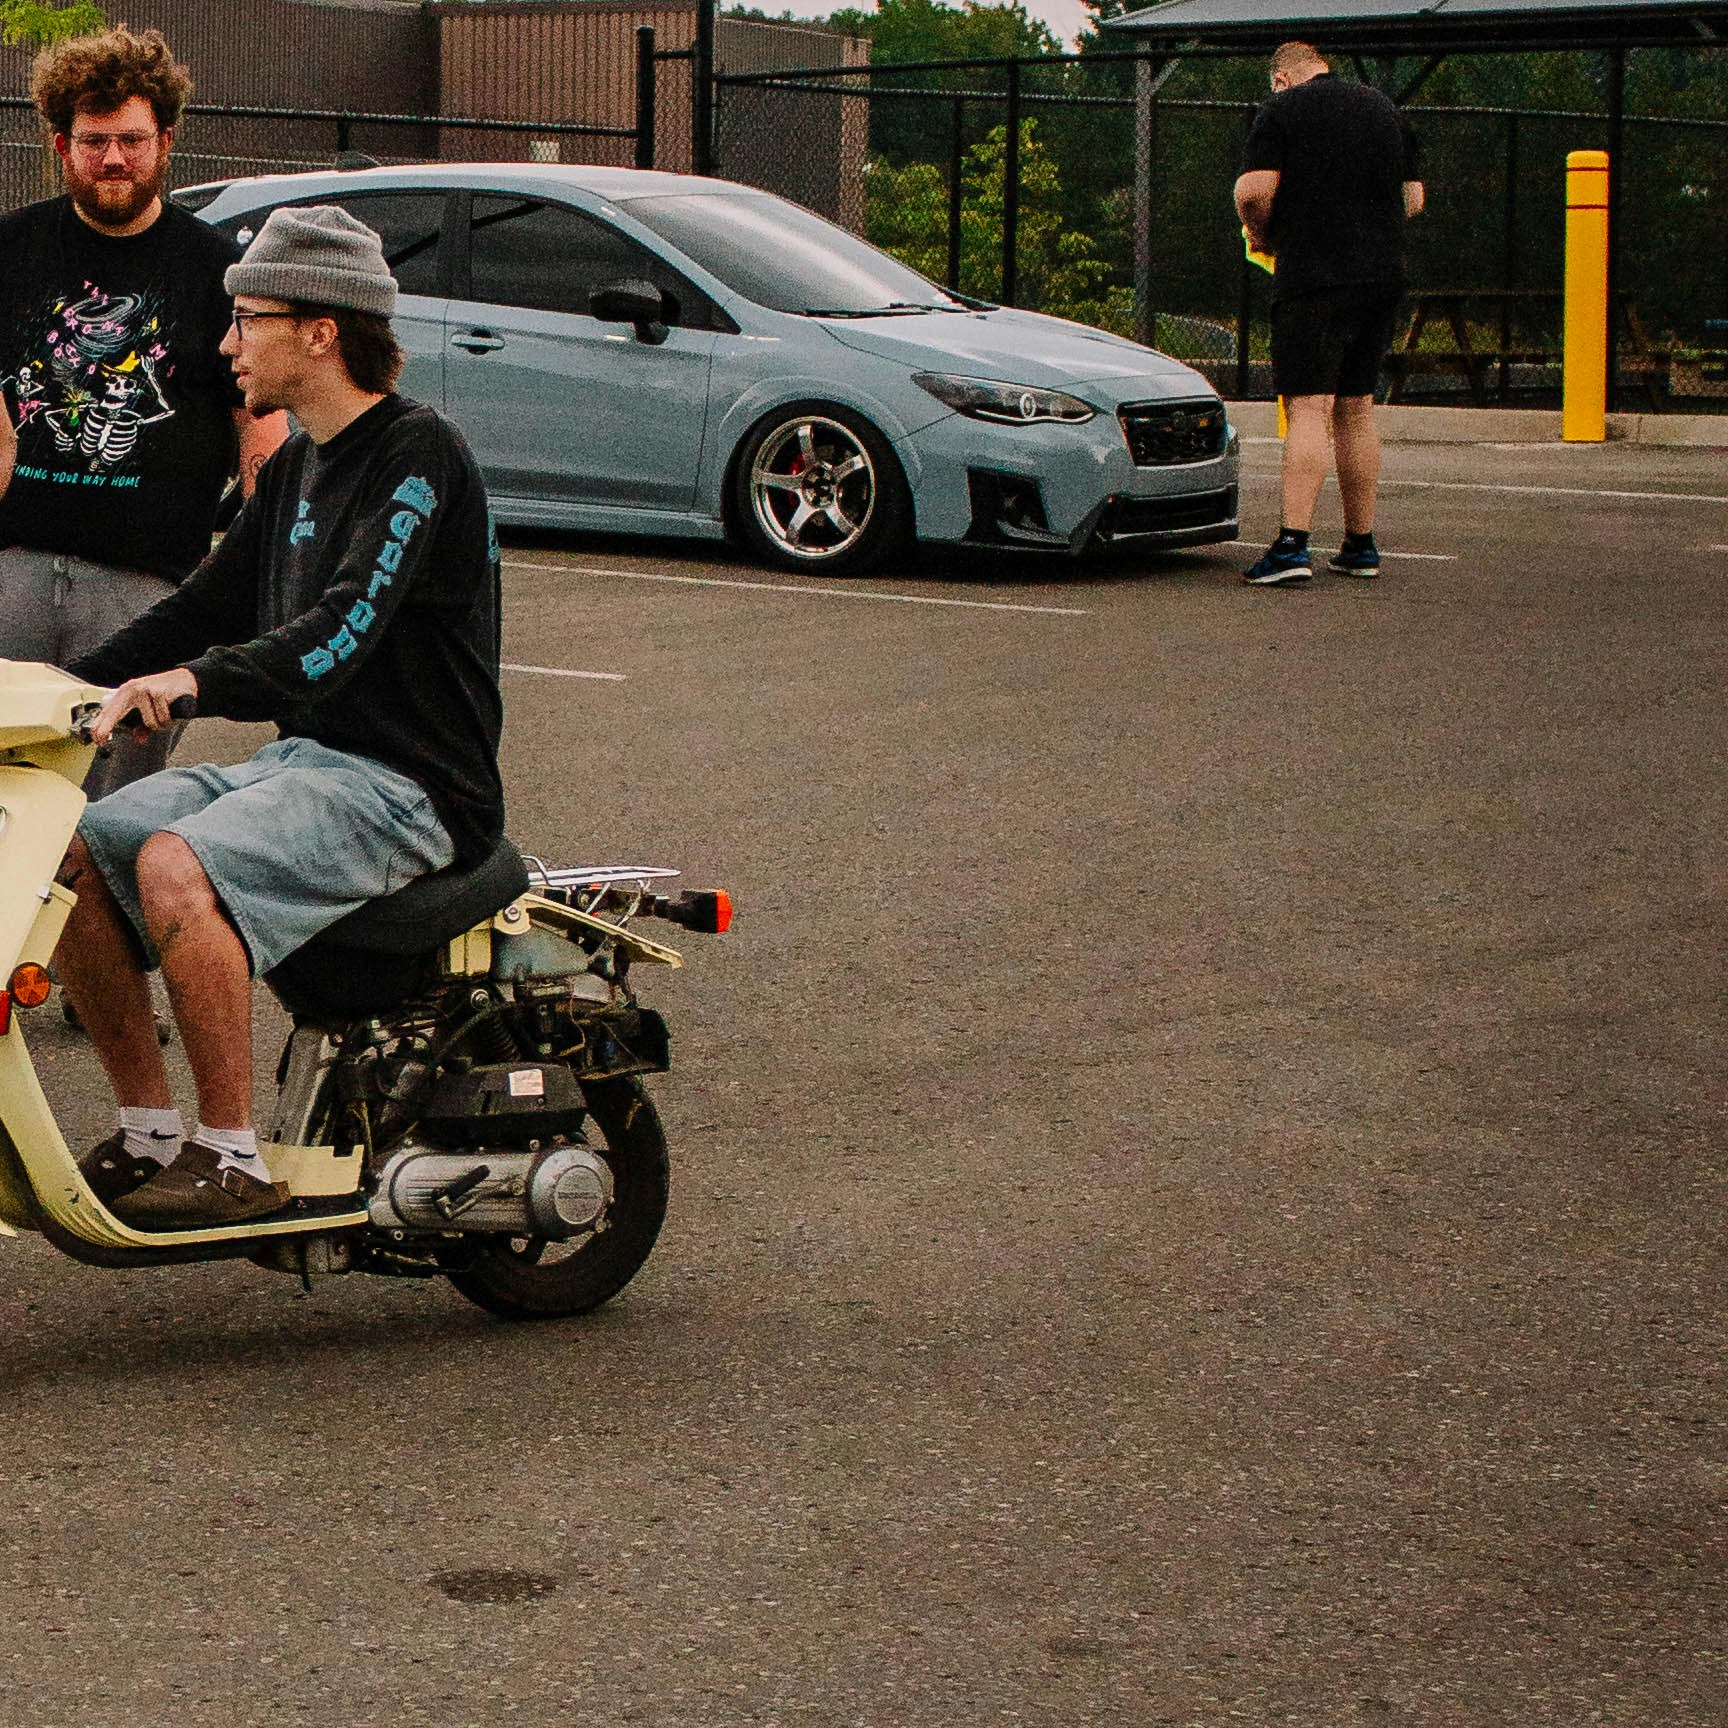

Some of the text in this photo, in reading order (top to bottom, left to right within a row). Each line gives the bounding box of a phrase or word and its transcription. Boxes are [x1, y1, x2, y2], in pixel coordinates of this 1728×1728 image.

[13, 463, 142, 488] INDING YOUR WAY HOME
